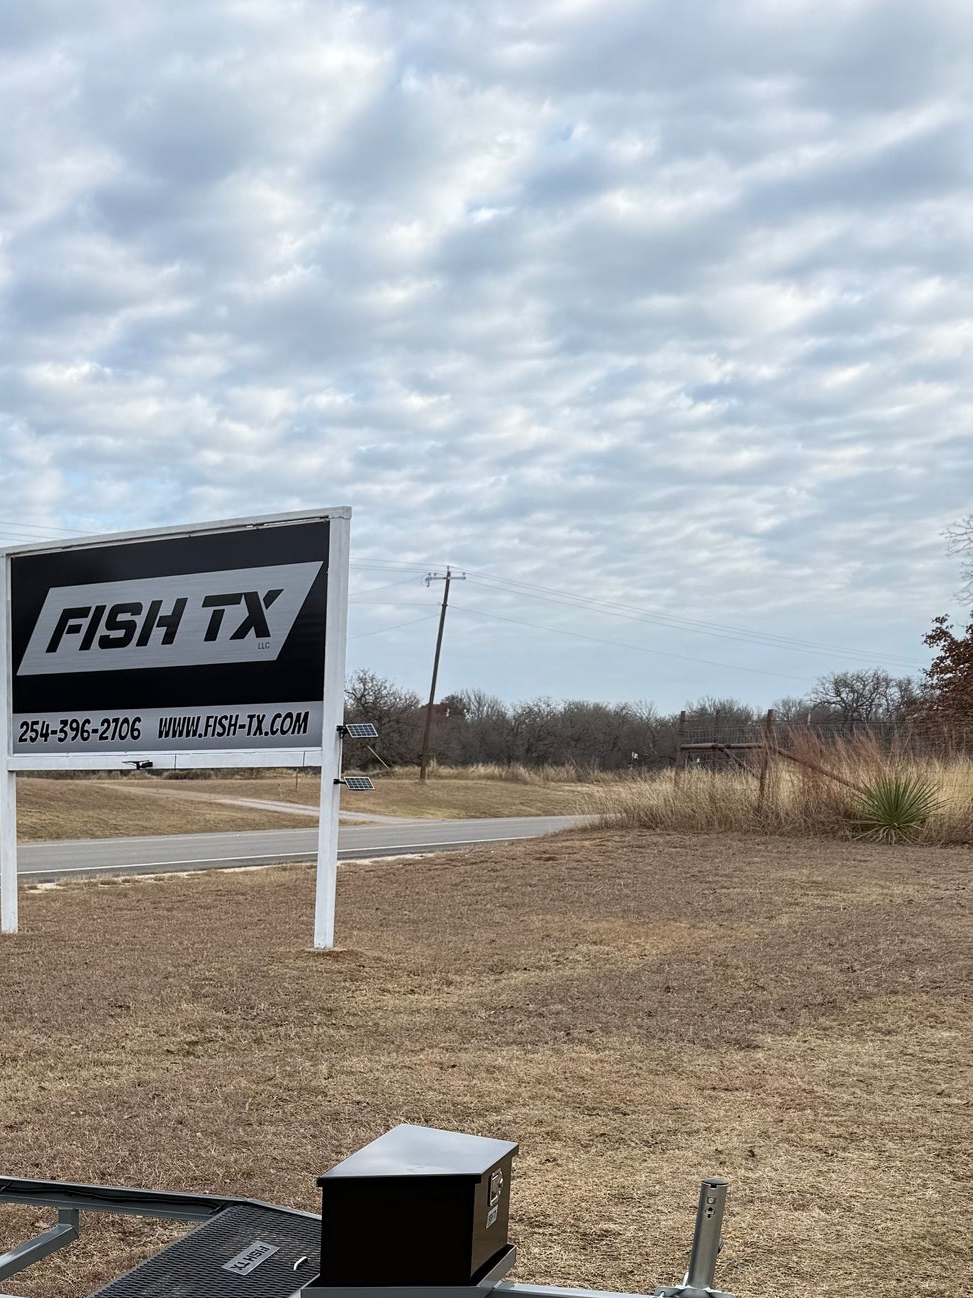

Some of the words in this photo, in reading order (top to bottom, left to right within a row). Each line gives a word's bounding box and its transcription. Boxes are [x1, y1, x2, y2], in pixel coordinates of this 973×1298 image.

[45, 597, 189, 653] FISH
[202, 588, 284, 642] TX
[257, 641, 271, 650] LLC
[18, 716, 142, 743] 254-396-2706
[158, 711, 310, 739] WWW.FISH-TX.COM
[243, 1245, 270, 1262] FISH
